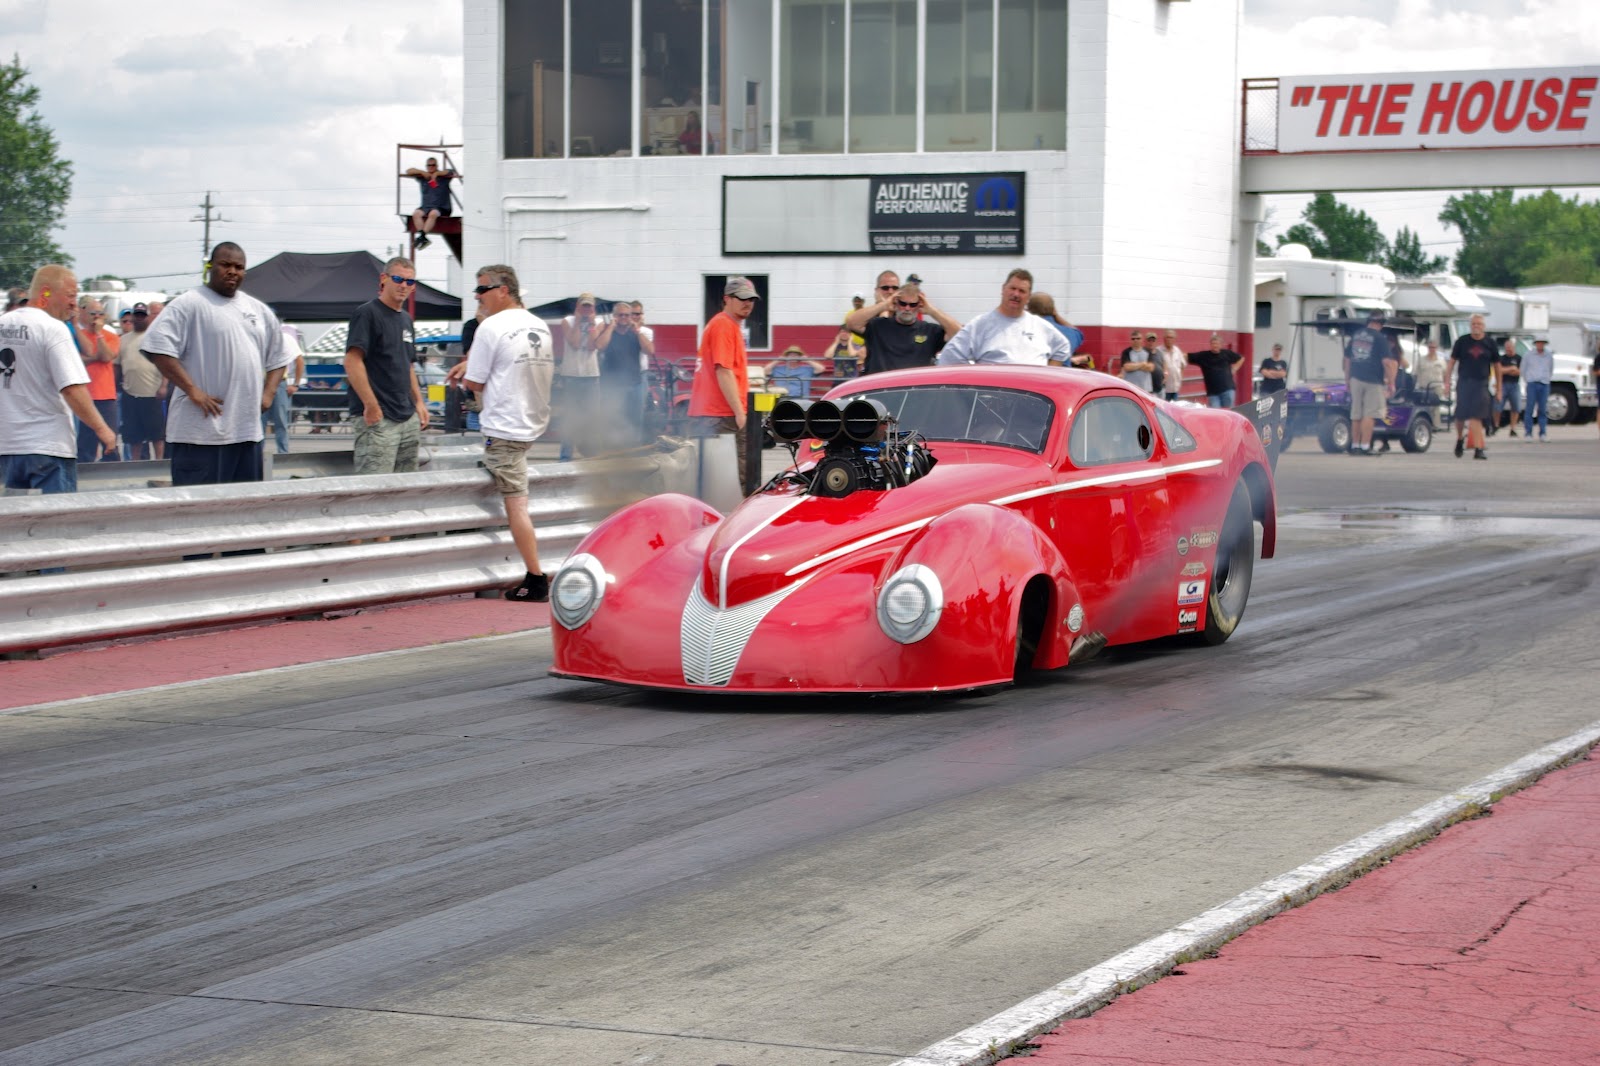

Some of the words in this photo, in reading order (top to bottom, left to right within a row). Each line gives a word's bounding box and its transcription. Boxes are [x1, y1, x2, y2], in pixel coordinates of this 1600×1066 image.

[1290, 83, 1414, 138] "THE
[1418, 77, 1599, 135] HOUSE
[877, 183, 968, 199] AUTHENTIC
[875, 200, 967, 213] PERFORMANCE
[1178, 609, 1197, 623] Coan
